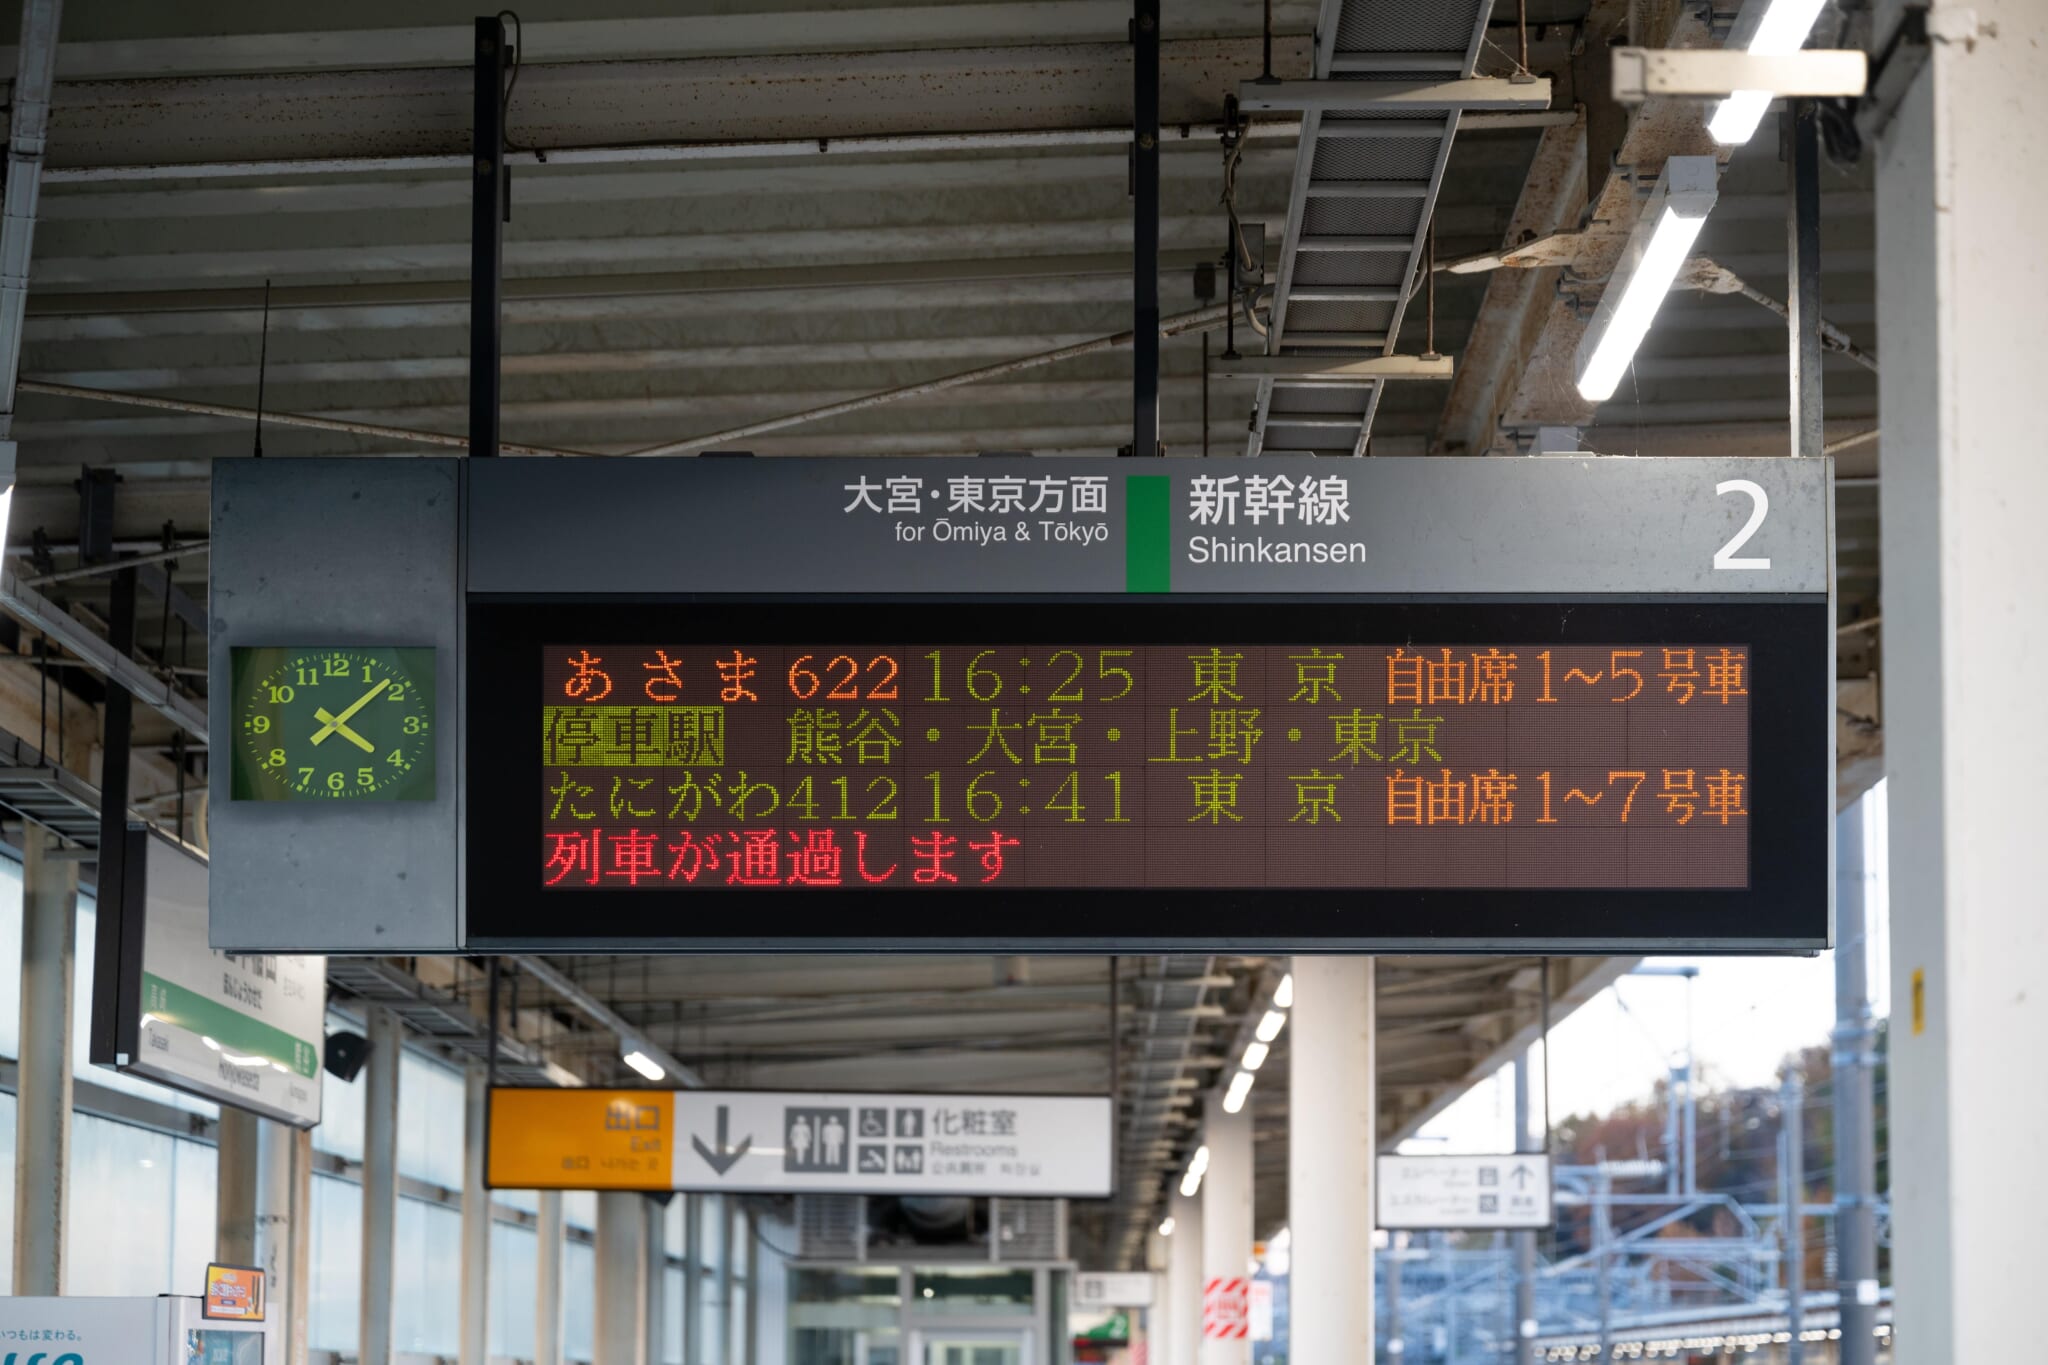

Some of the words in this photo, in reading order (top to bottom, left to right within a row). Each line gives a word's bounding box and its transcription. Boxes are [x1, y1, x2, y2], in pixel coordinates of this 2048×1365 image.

[843, 475, 1108, 514] 大宮・東京方面
[1189, 475, 1350, 525] 新幹線
[895, 521, 925, 541] for
[933, 518, 1007, 546] Ōmiya
[1014, 521, 1031, 542] &
[1039, 521, 1109, 546] Tōkyō
[1713, 479, 1771, 569] 2
[1188, 535, 1367, 564] Shinkansen
[296, 668, 319, 686] 11
[323, 659, 350, 677] 12
[361, 665, 373, 683] 1
[924, 650, 1134, 702] 16:25
[268, 685, 295, 703] 10
[387, 683, 405, 701] 2
[253, 715, 270, 734] 9
[403, 716, 420, 734] 3
[545, 706, 724, 765] 停車駅
[268, 748, 286, 766] 8
[386, 749, 405, 766] 4
[298, 767, 315, 785] 7
[327, 772, 345, 790] 6
[357, 767, 374, 786] 5
[924, 771, 1131, 822] 16:41
[545, 828, 1021, 885] 列車が通過します
